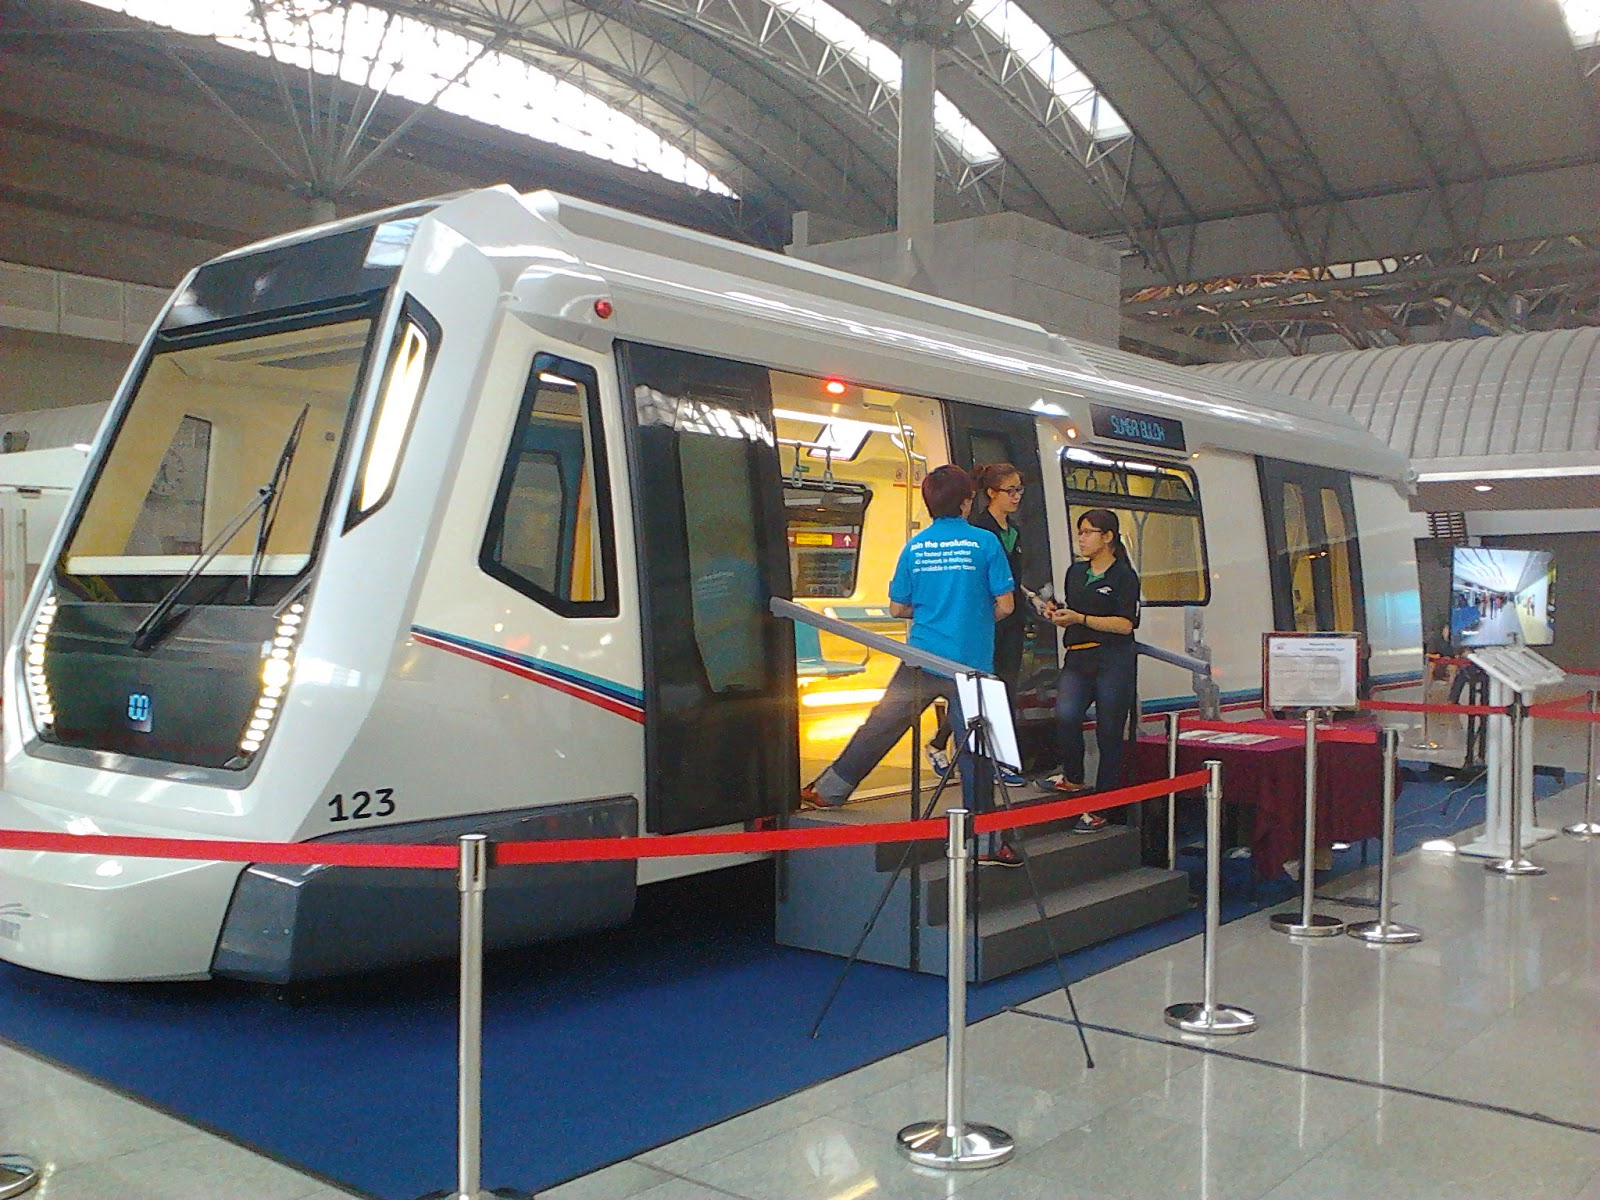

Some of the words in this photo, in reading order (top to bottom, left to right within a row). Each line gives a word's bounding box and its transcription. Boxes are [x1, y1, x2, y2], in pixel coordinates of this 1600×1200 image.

[910, 542, 923, 552] Join
[924, 540, 938, 548] the
[328, 788, 395, 822] 123
